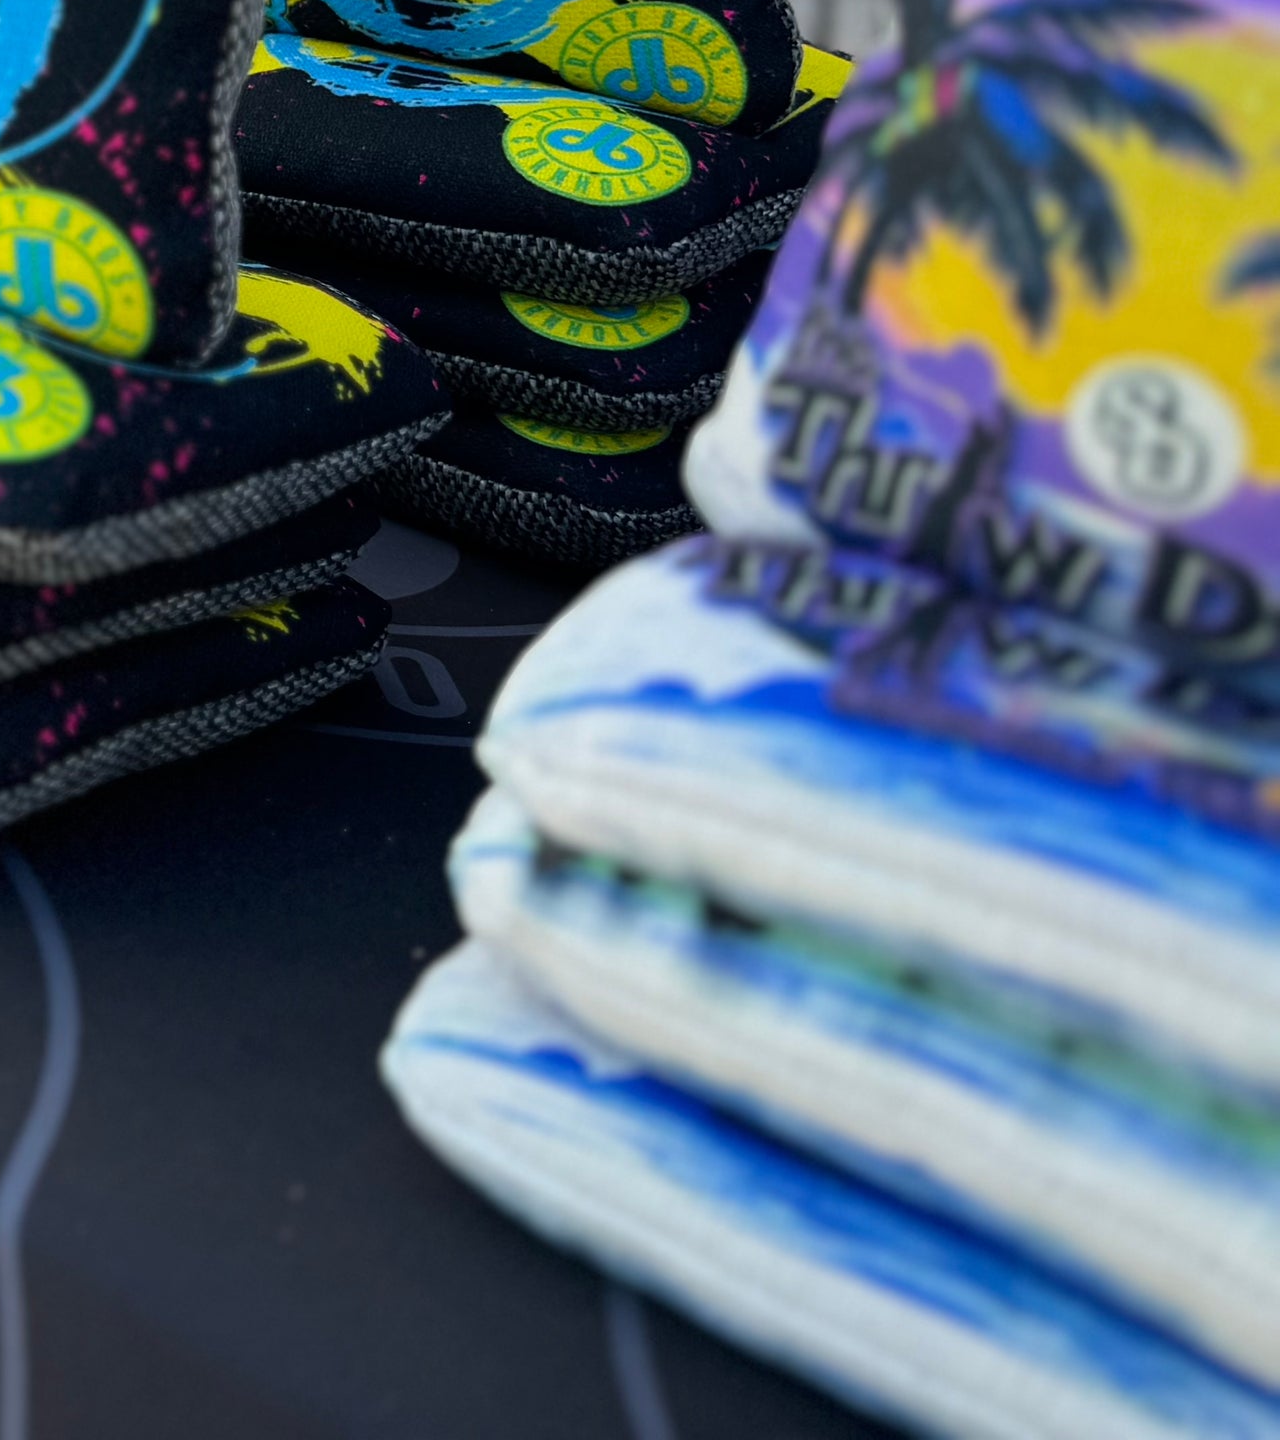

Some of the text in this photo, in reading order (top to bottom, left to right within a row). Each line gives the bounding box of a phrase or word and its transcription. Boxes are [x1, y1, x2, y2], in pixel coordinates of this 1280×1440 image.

[562, 10, 733, 68] DIRTY BAGS
[523, 303, 651, 343] RNHOLE
